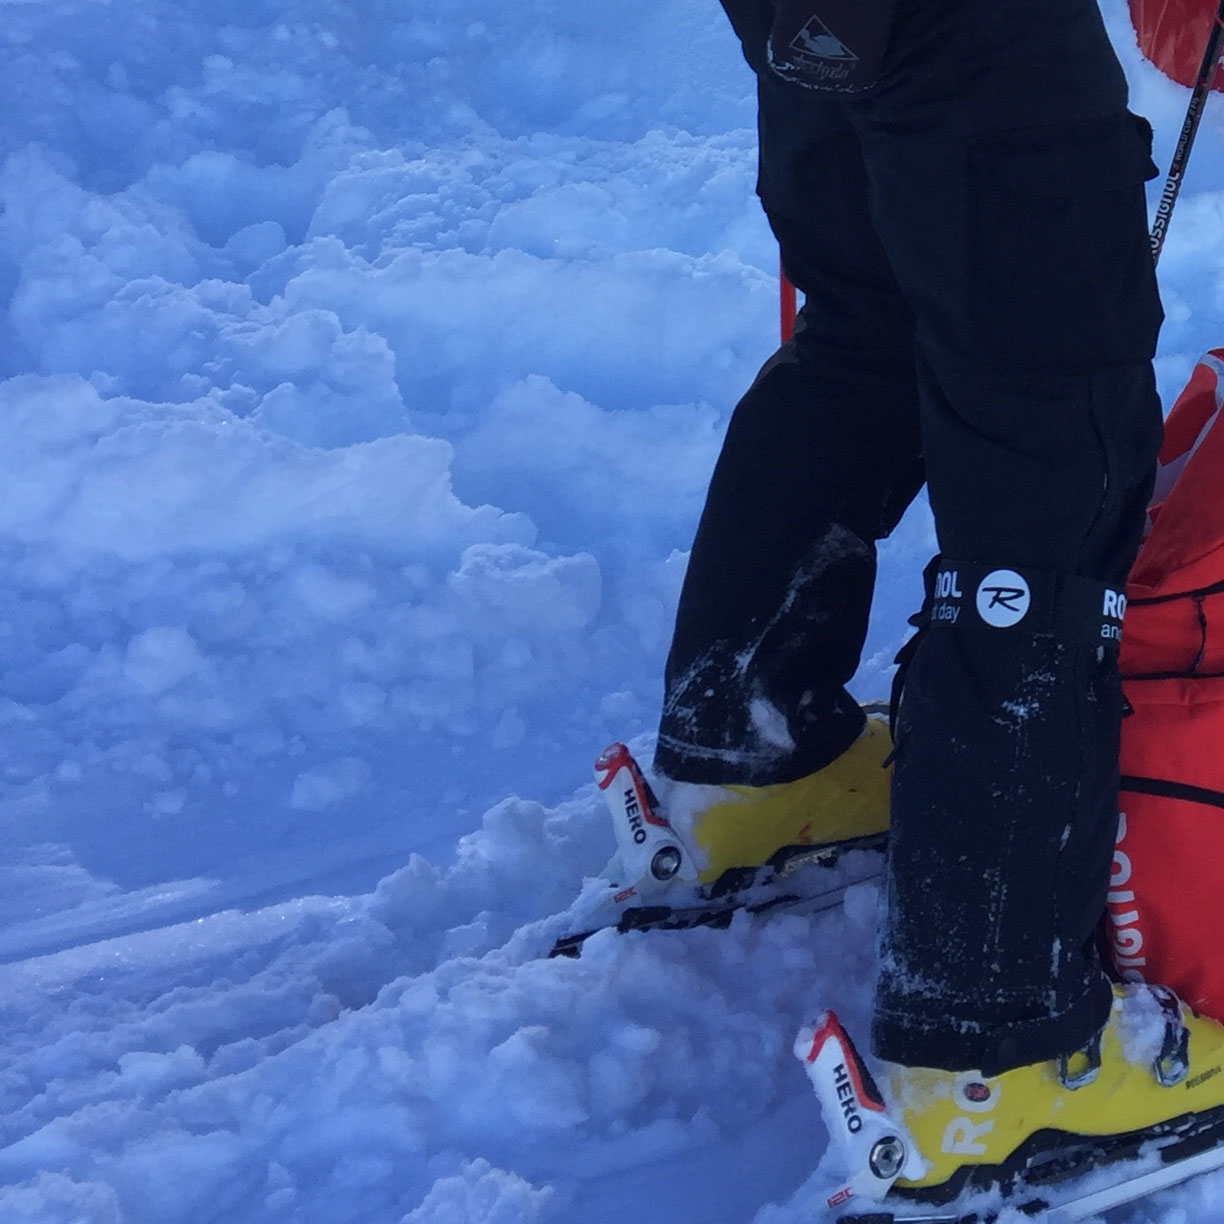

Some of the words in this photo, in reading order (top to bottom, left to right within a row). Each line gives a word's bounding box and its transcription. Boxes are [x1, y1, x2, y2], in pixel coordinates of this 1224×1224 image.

[1150, 172, 1180, 256] OSSIGNOL
[939, 602, 961, 624] day
[624, 788, 646, 844] HERO
[833, 1063, 863, 1134] HERO
